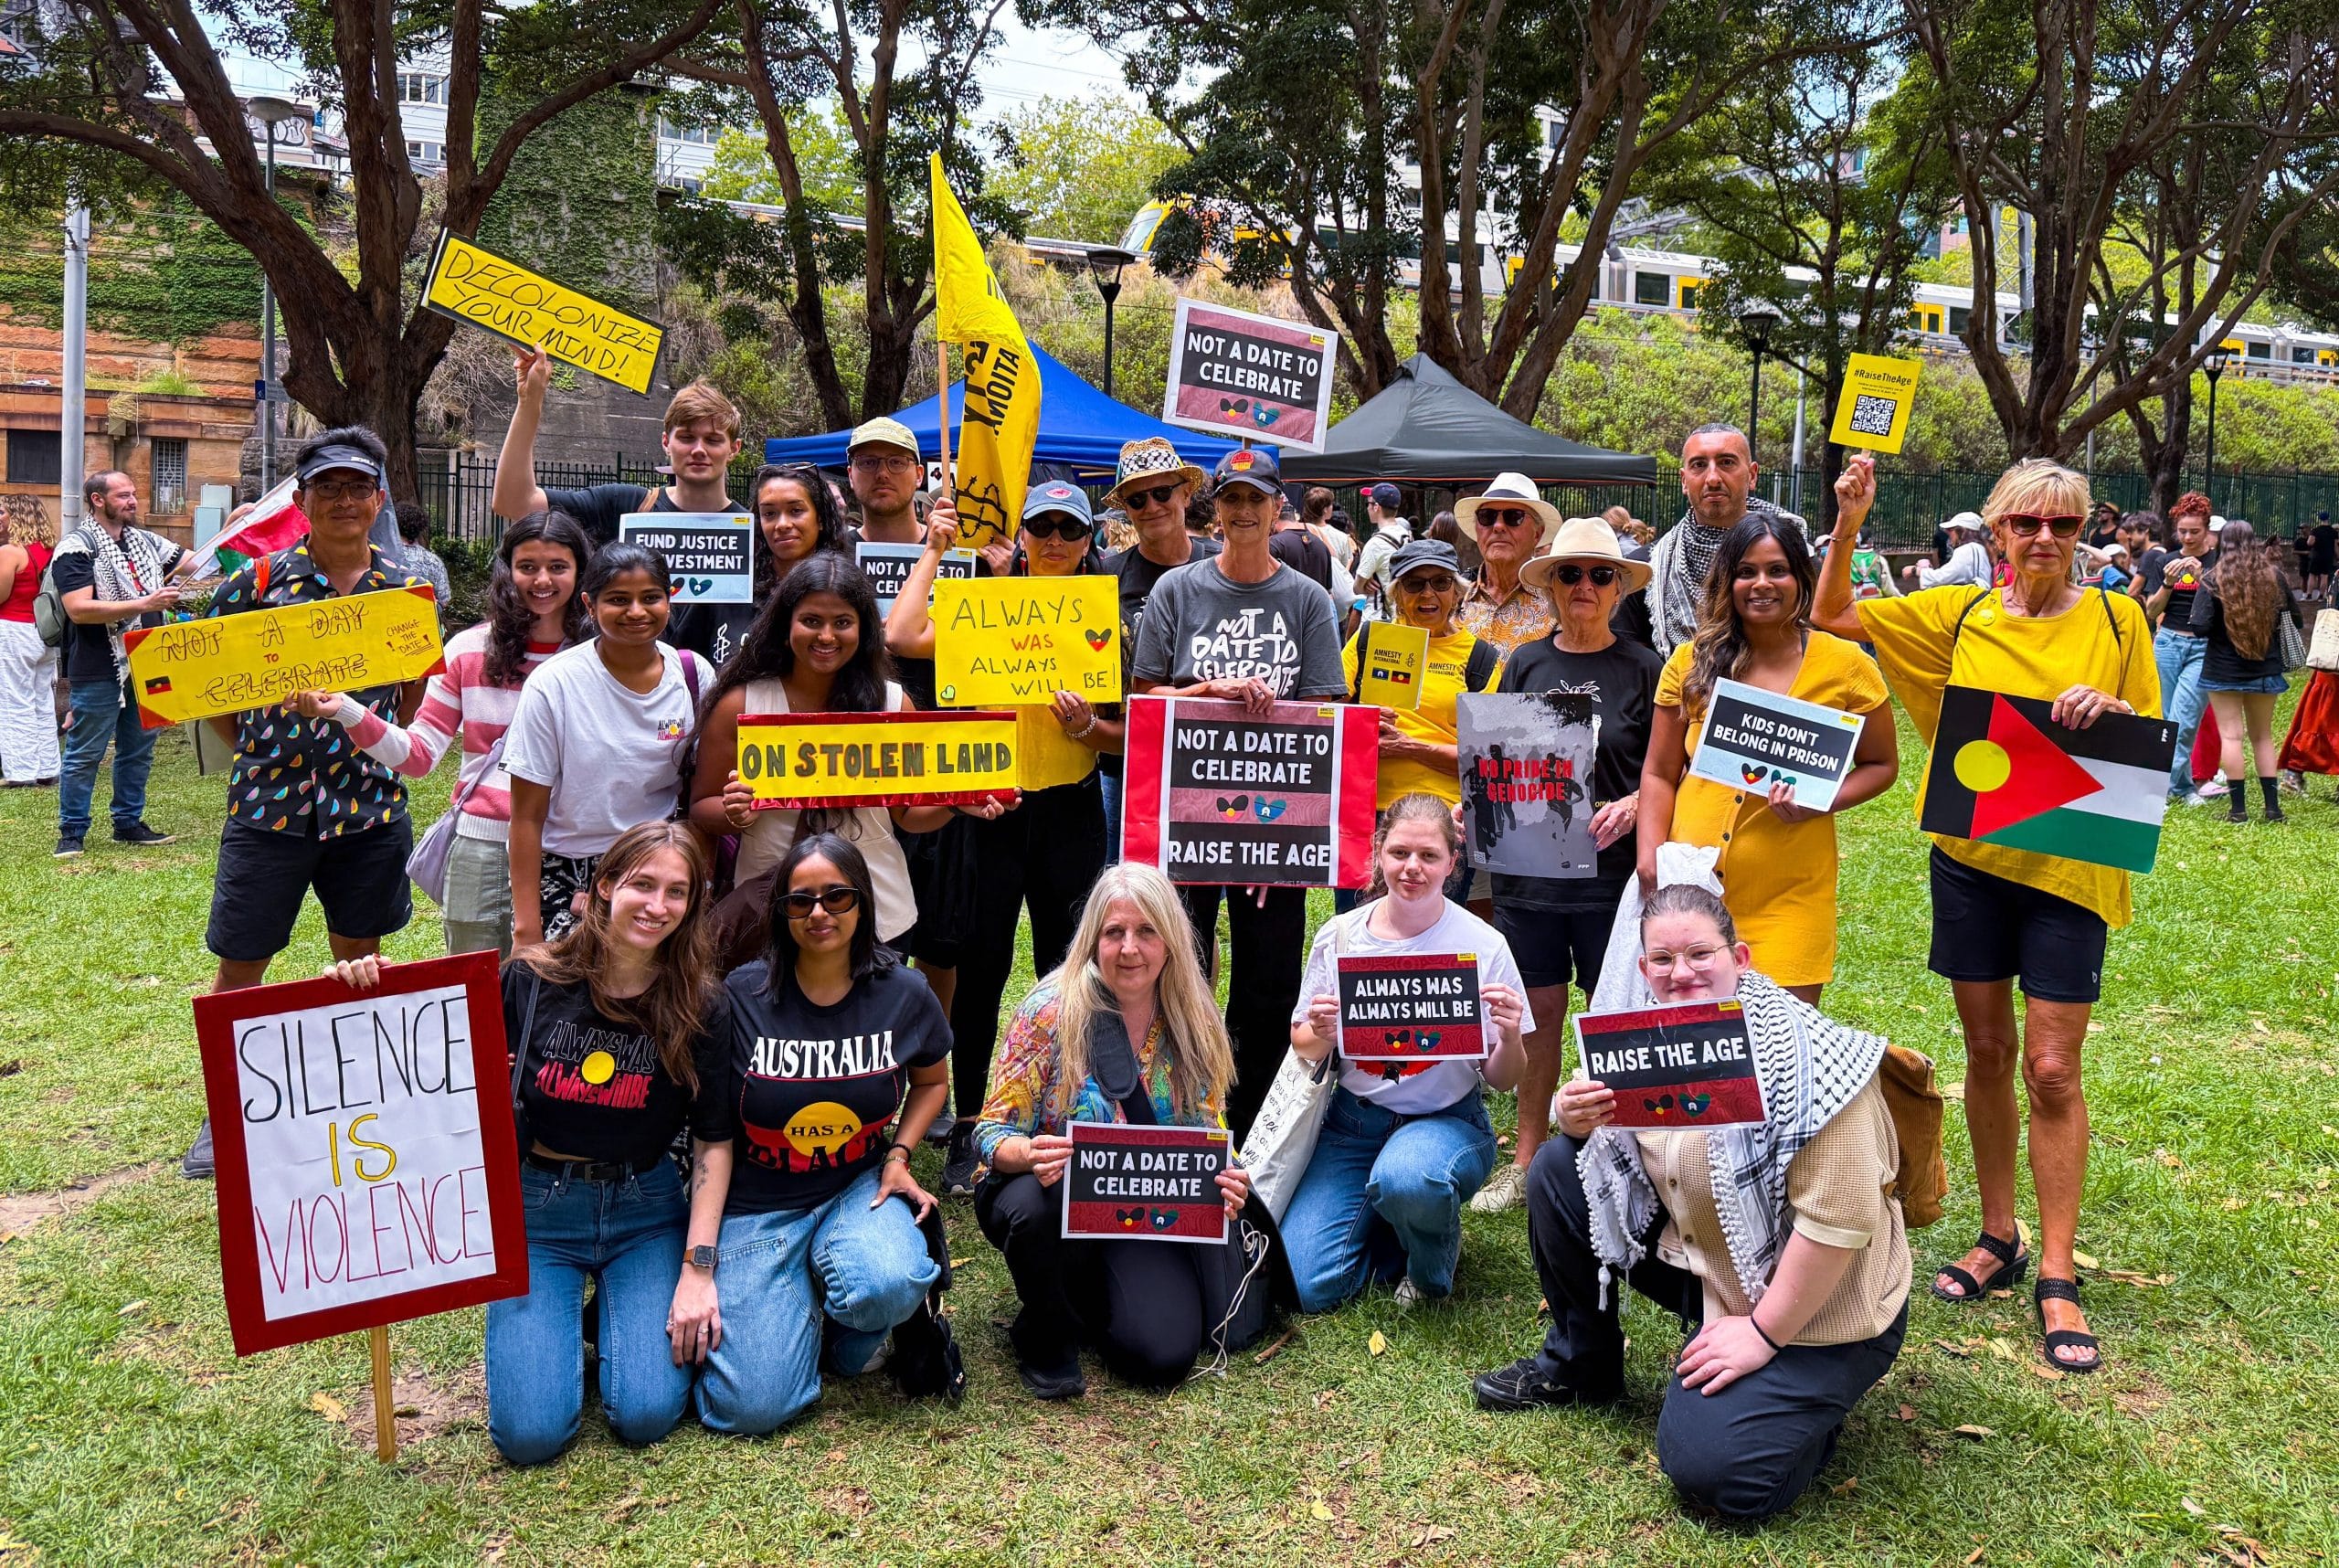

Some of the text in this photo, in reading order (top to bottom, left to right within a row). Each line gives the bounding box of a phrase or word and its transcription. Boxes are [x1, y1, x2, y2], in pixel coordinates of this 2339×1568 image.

[445, 249, 662, 354] DECOLONIZE
[452, 284, 630, 377] YOUR MIND!
[1188, 332, 1318, 377] NOT A DATE TO
[1199, 361, 1303, 400] CELEBRATE
[1854, 368, 1911, 386] #RaiseTheAge
[636, 534, 737, 550] FUND JUSTICE
[662, 554, 744, 570] VESTMENT
[866, 561, 894, 576] NOT
[896, 562, 906, 576] A
[948, 567, 965, 578] TO
[950, 595, 1083, 630] ALWAYS
[1216, 608, 1287, 638] NOT A
[158, 601, 365, 663] NOT A DAY
[386, 619, 420, 637] CHANGE
[400, 630, 418, 641] THE
[1011, 633, 1054, 652] WAS
[1191, 633, 1298, 664] DATE TO
[1374, 648, 1402, 659] AMNESTY
[263, 652, 279, 664] TO
[969, 656, 1057, 675] ALWAYS
[1428, 662, 1457, 671] AMNESTY
[201, 652, 368, 707] CELEBRATE
[1011, 678, 1070, 696] WILL
[1177, 728, 1329, 756] NOT A DATE TO
[1741, 713, 1820, 747] KIDS DON'T
[1713, 724, 1839, 772] BELONG IN PRISON
[742, 742, 1011, 780] ON STOLEN LAND
[1191, 758, 1312, 785] CELEBRATE
[1478, 758, 1574, 779] NO PRIDE IN
[1487, 782, 1567, 802] GENOCIDE
[1168, 841, 1331, 868] RAISE THE AGE
[1355, 977, 1464, 998] ALWAYS WAS
[1348, 1000, 1474, 1021] ALWAYS WILL BE
[239, 995, 477, 1123] SILENCE
[747, 1030, 899, 1079] AUSTRALIA
[1591, 1036, 1747, 1075] RAISE THE AGE
[790, 1124, 855, 1137] HAS A
[328, 1113, 397, 1188] IS
[1080, 1150, 1218, 1172] NOT A DATE TO
[1093, 1176, 1202, 1197] CELEBRATE
[254, 1165, 493, 1295] VIOLENCE
